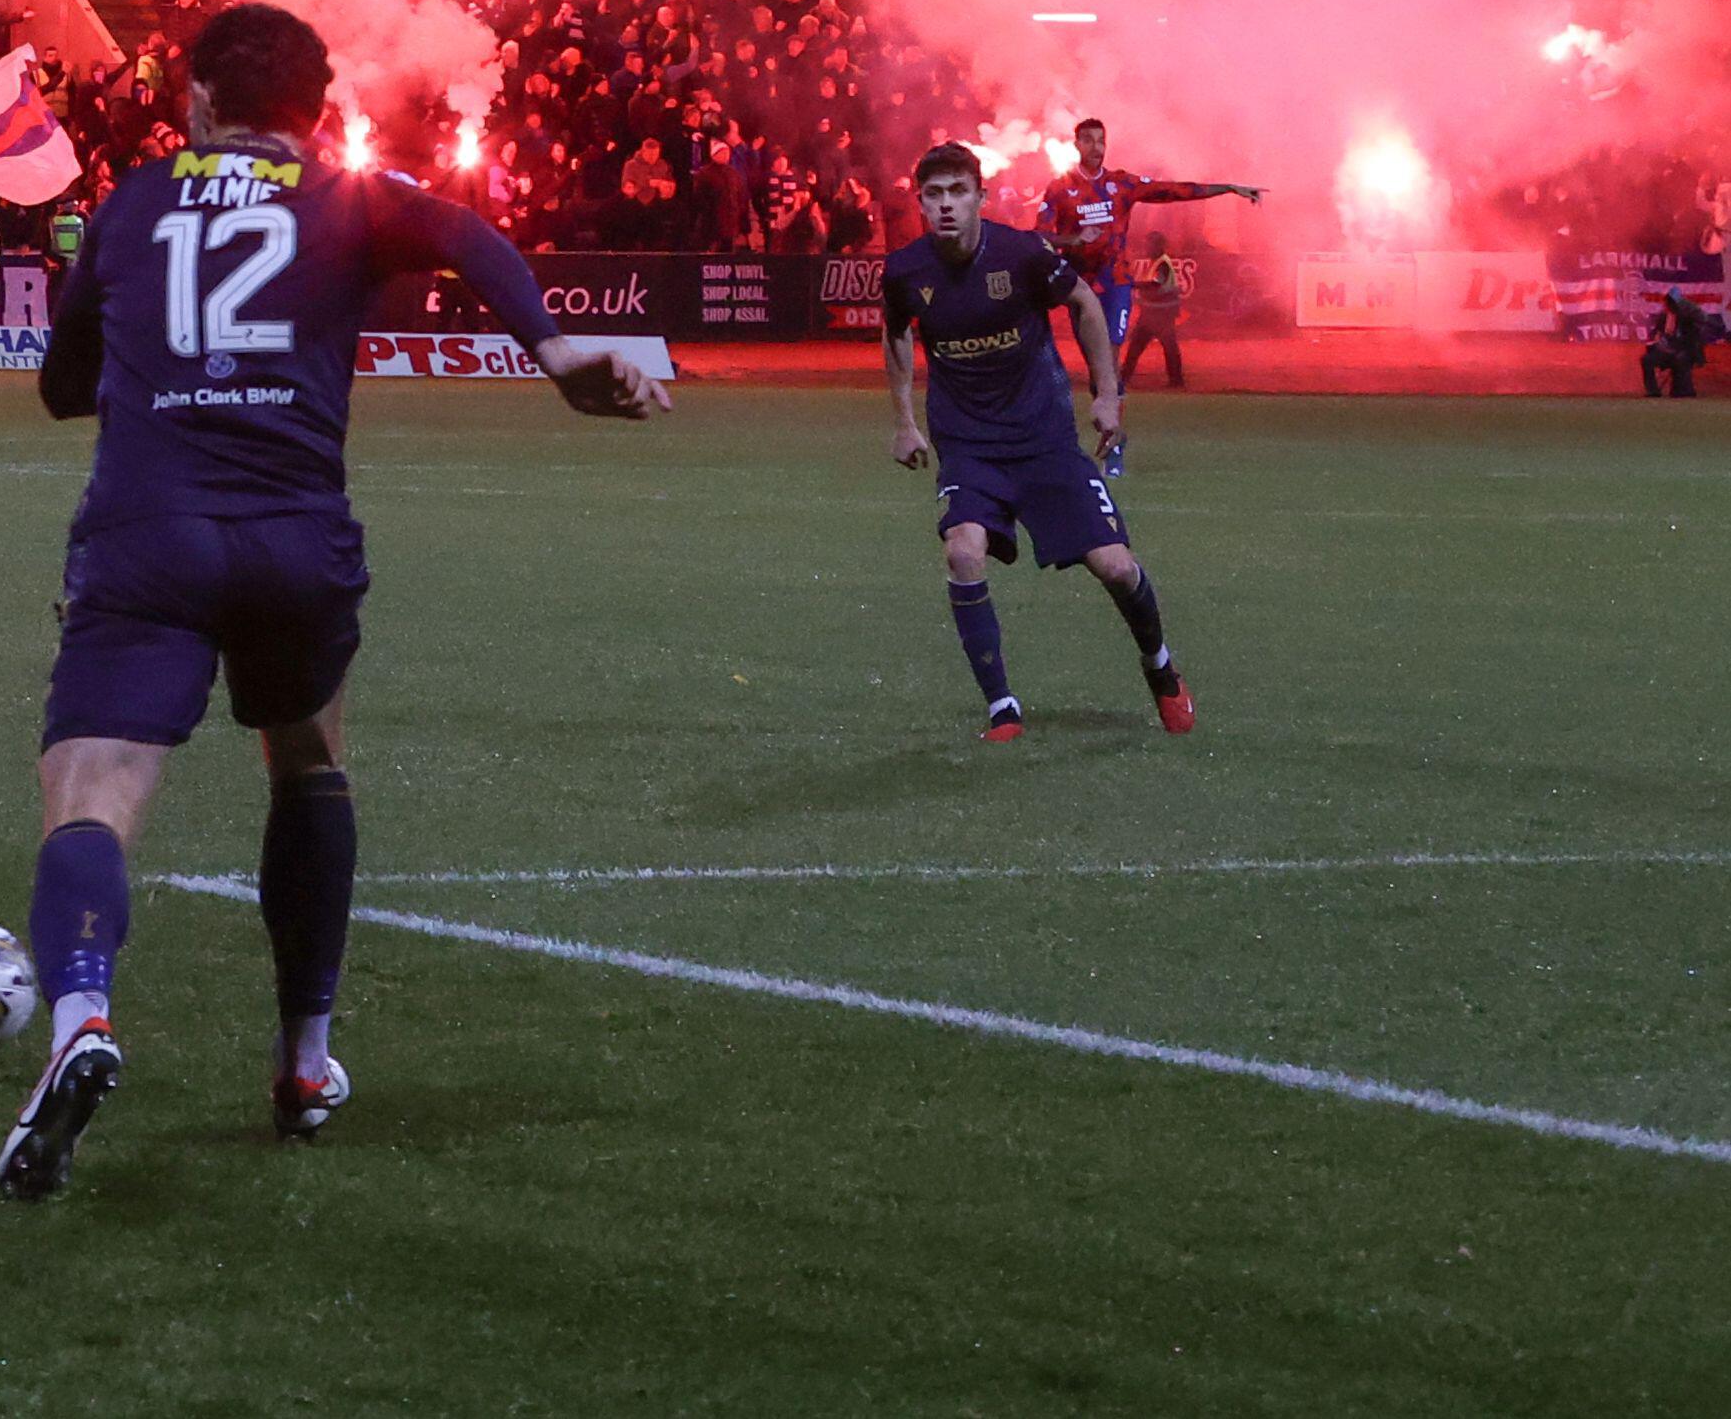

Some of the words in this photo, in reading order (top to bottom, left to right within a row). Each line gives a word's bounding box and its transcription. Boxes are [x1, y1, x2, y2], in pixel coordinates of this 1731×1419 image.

[171, 151, 302, 188] MKM
[1076, 201, 1114, 214] UNIBET
[1579, 252, 1688, 271] LARKHALL
[152, 204, 298, 358] 12
[845, 308, 881, 325] 013
[153, 392, 191, 410] John
[195, 388, 243, 404] Clark
[246, 387, 295, 404] BMW
